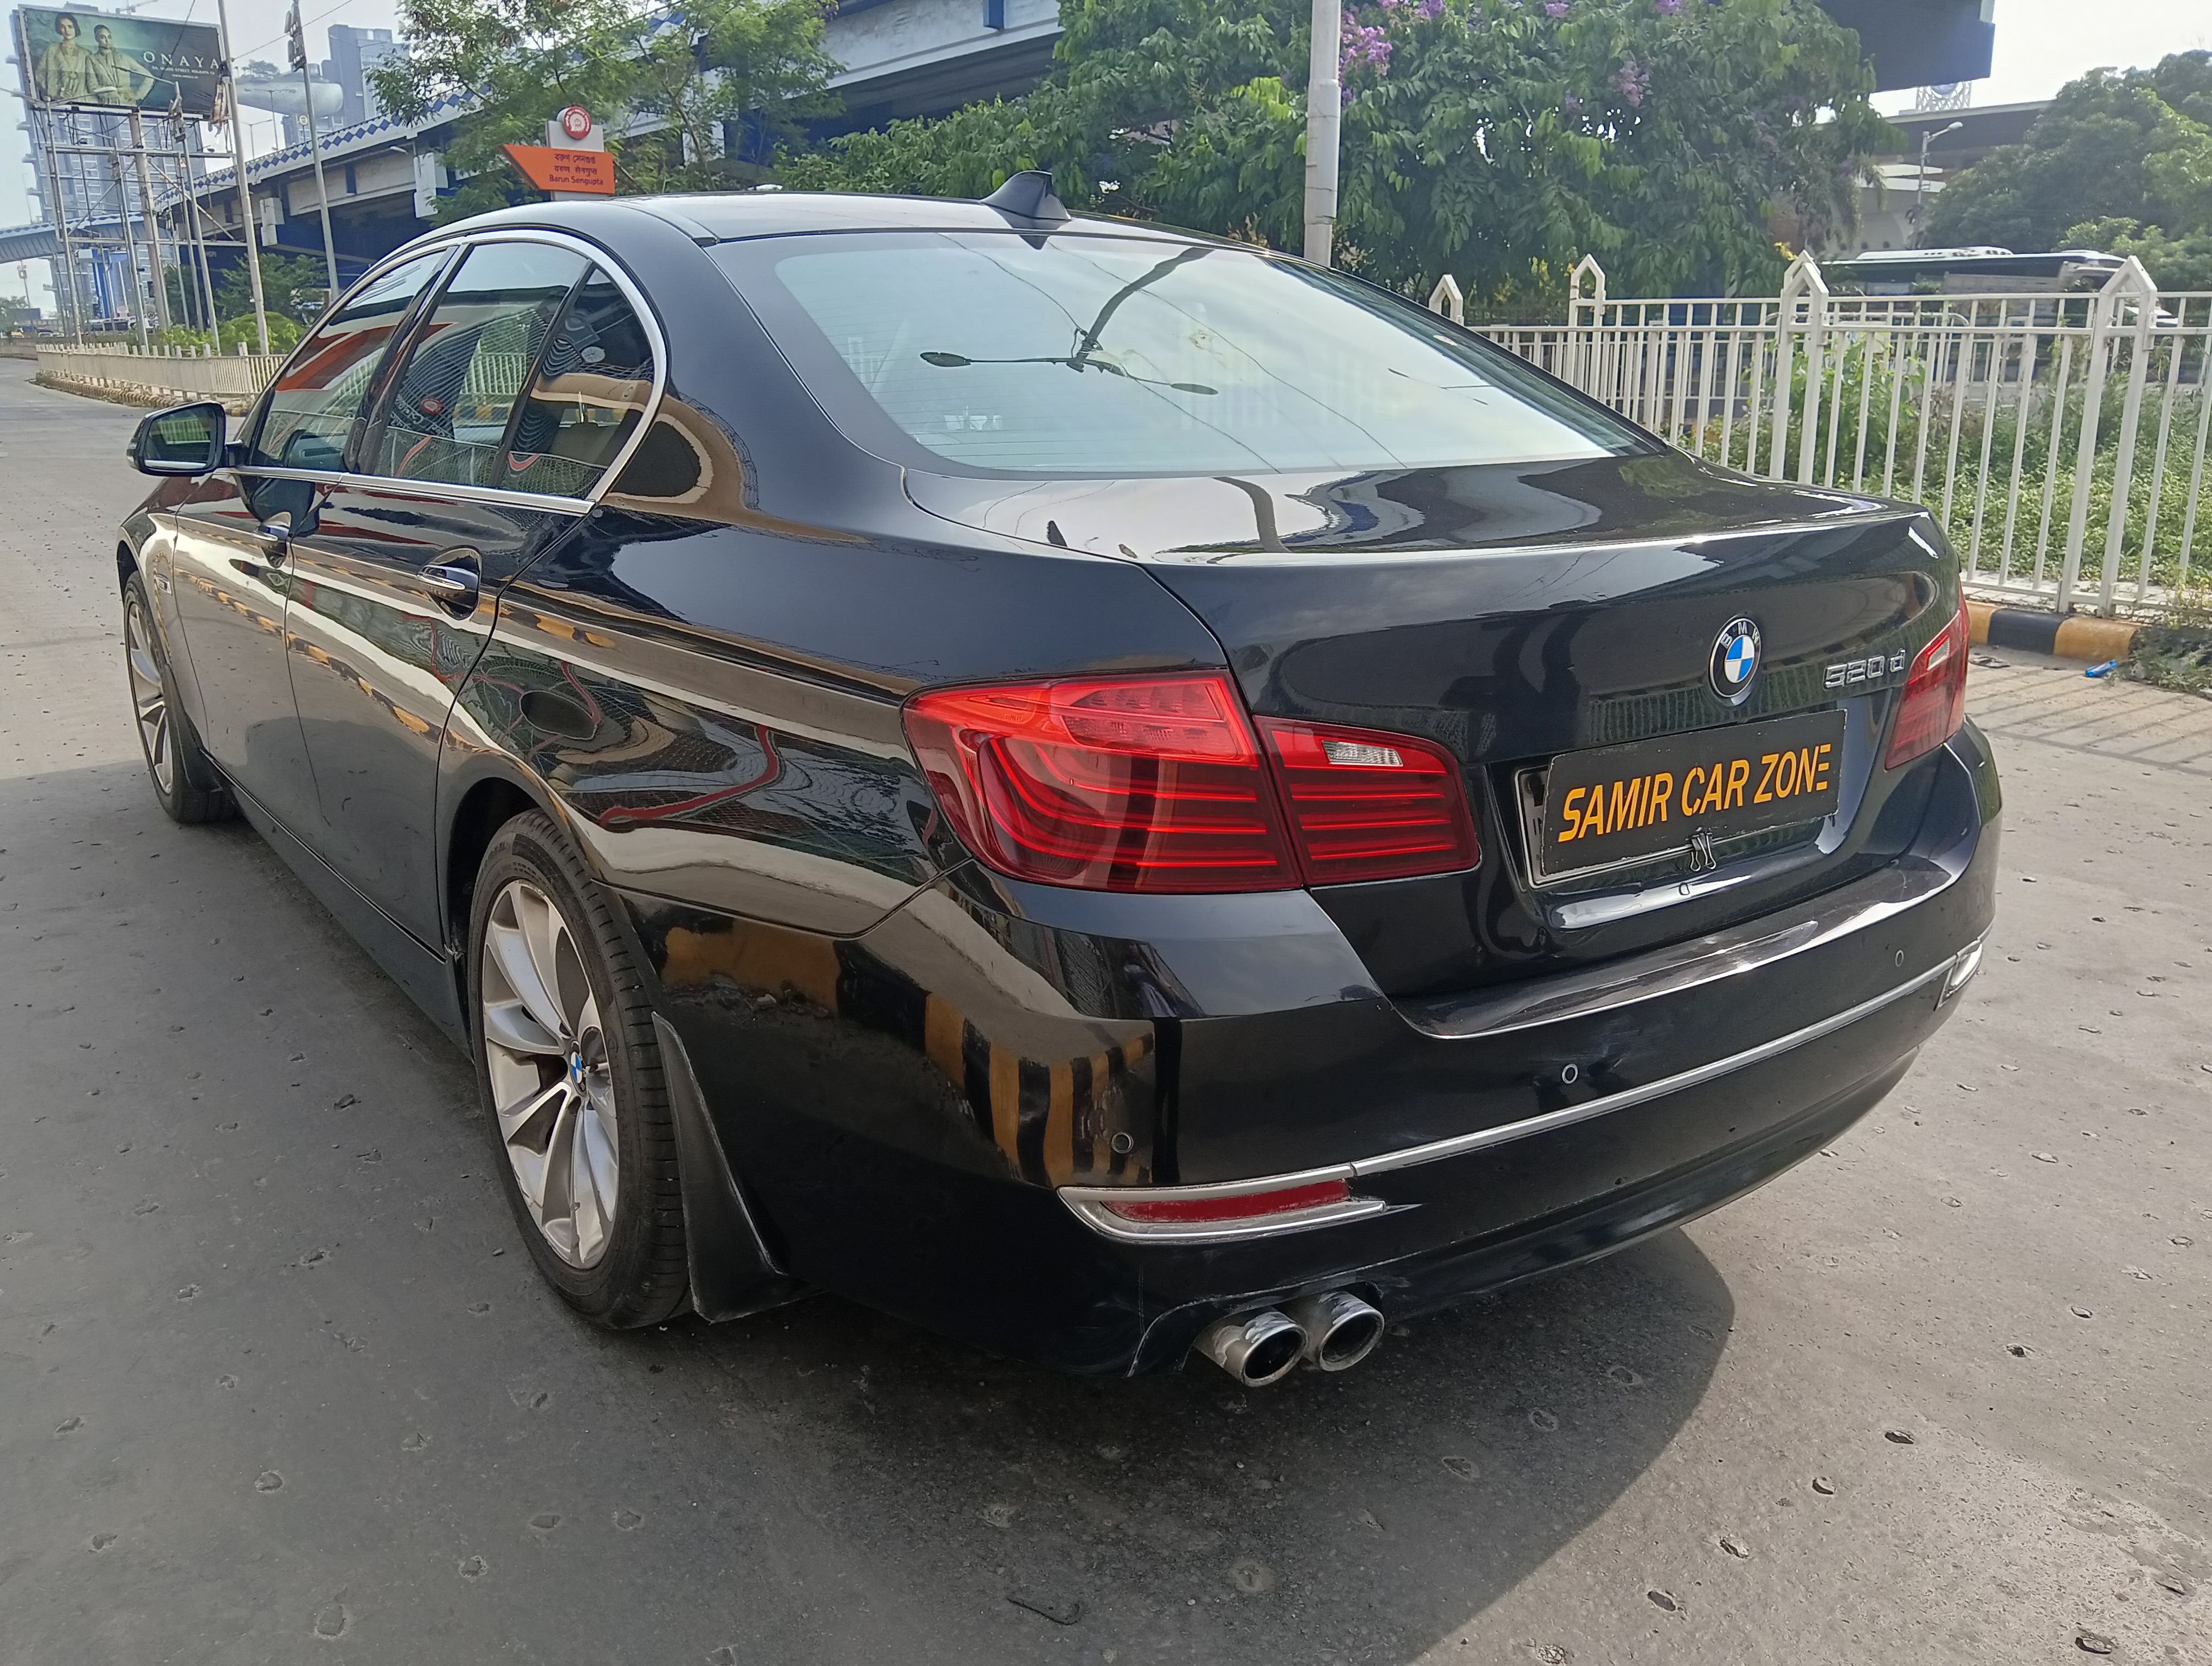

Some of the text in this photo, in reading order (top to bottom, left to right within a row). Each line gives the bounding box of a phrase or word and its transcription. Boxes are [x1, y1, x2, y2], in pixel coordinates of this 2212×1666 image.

[143, 52, 219, 69] ONAYA
[549, 174, 603, 186] Barun Sengupta
[1720, 621, 1760, 649] BMW
[1558, 743, 1832, 843] SAMIR CAR ZONE
